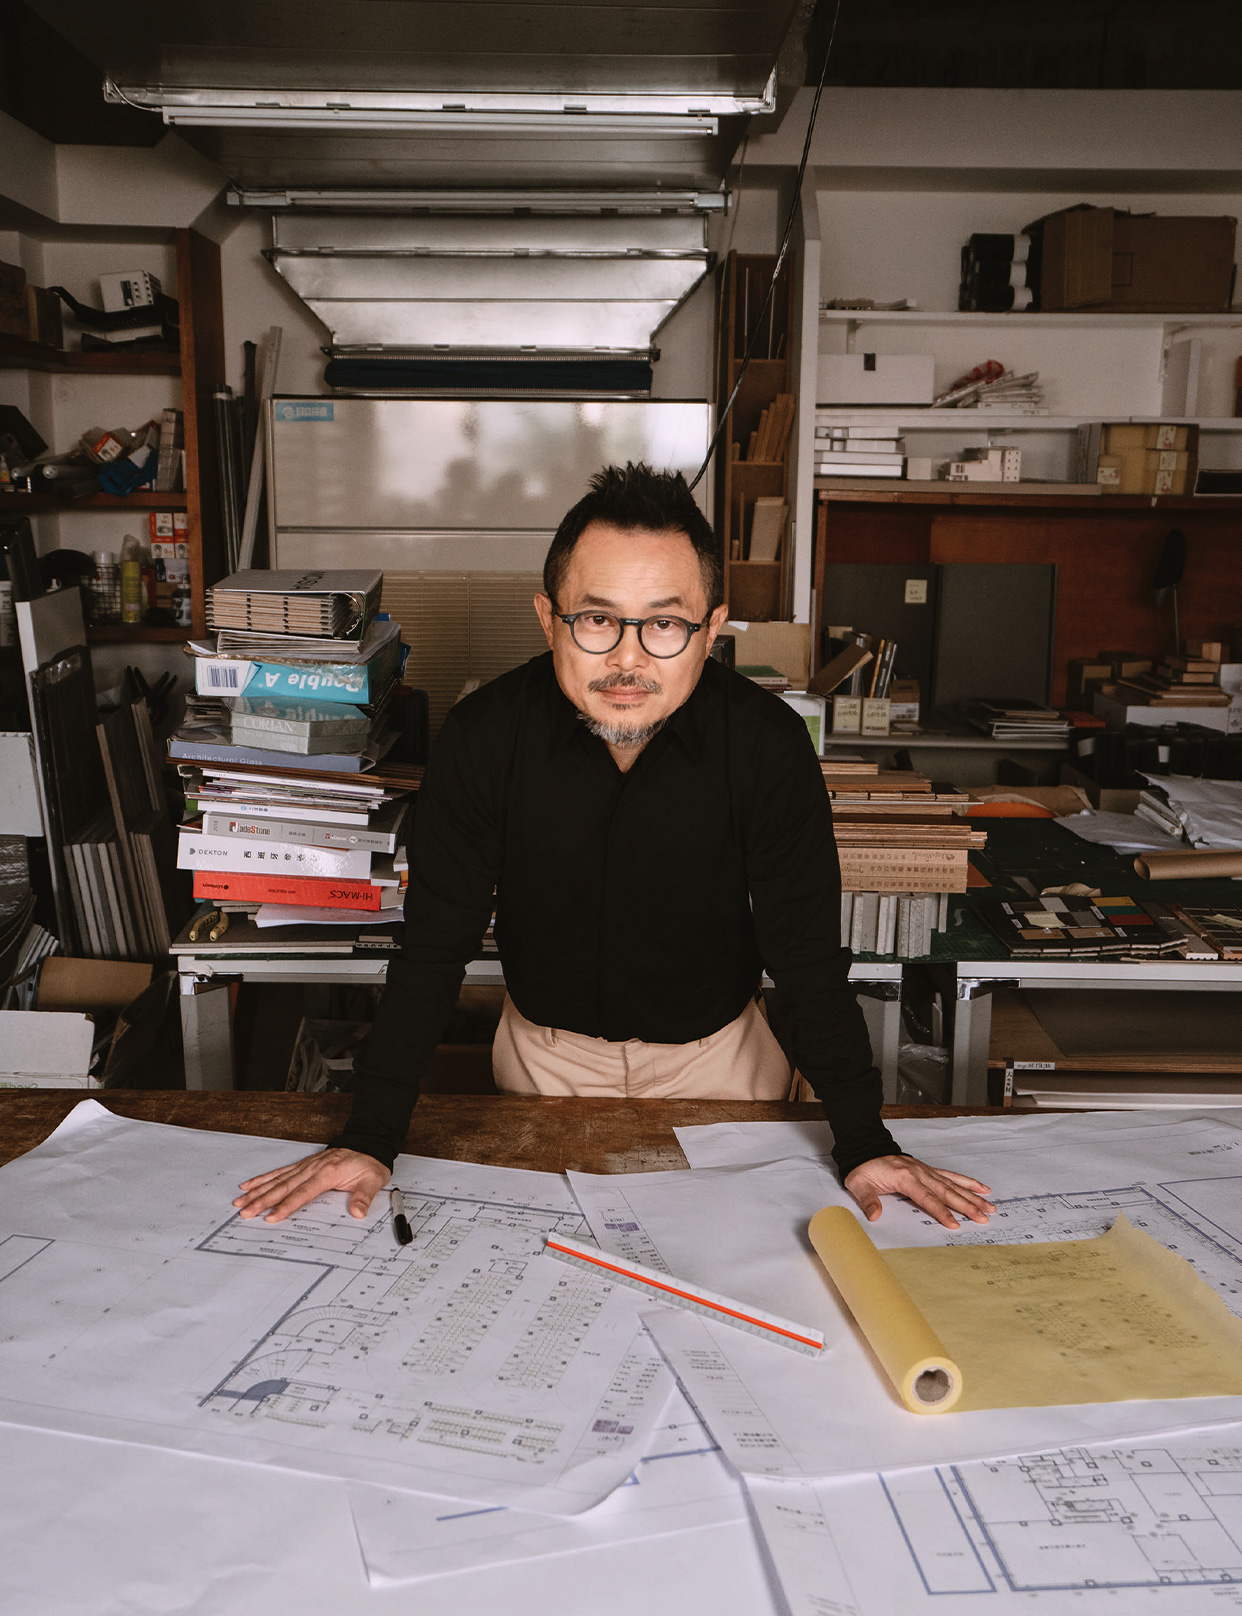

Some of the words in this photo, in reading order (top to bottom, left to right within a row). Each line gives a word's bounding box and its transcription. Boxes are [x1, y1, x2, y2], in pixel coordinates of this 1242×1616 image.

[265, 673, 281, 687] A
[287, 673, 360, 692] Double
[243, 716, 293, 733] CORIAN
[182, 753, 237, 764] Architectural
[239, 757, 263, 766] Glass
[229, 821, 271, 836] JadeStone
[198, 848, 228, 857] DEKTON
[329, 890, 373, 901] HI-MACS
